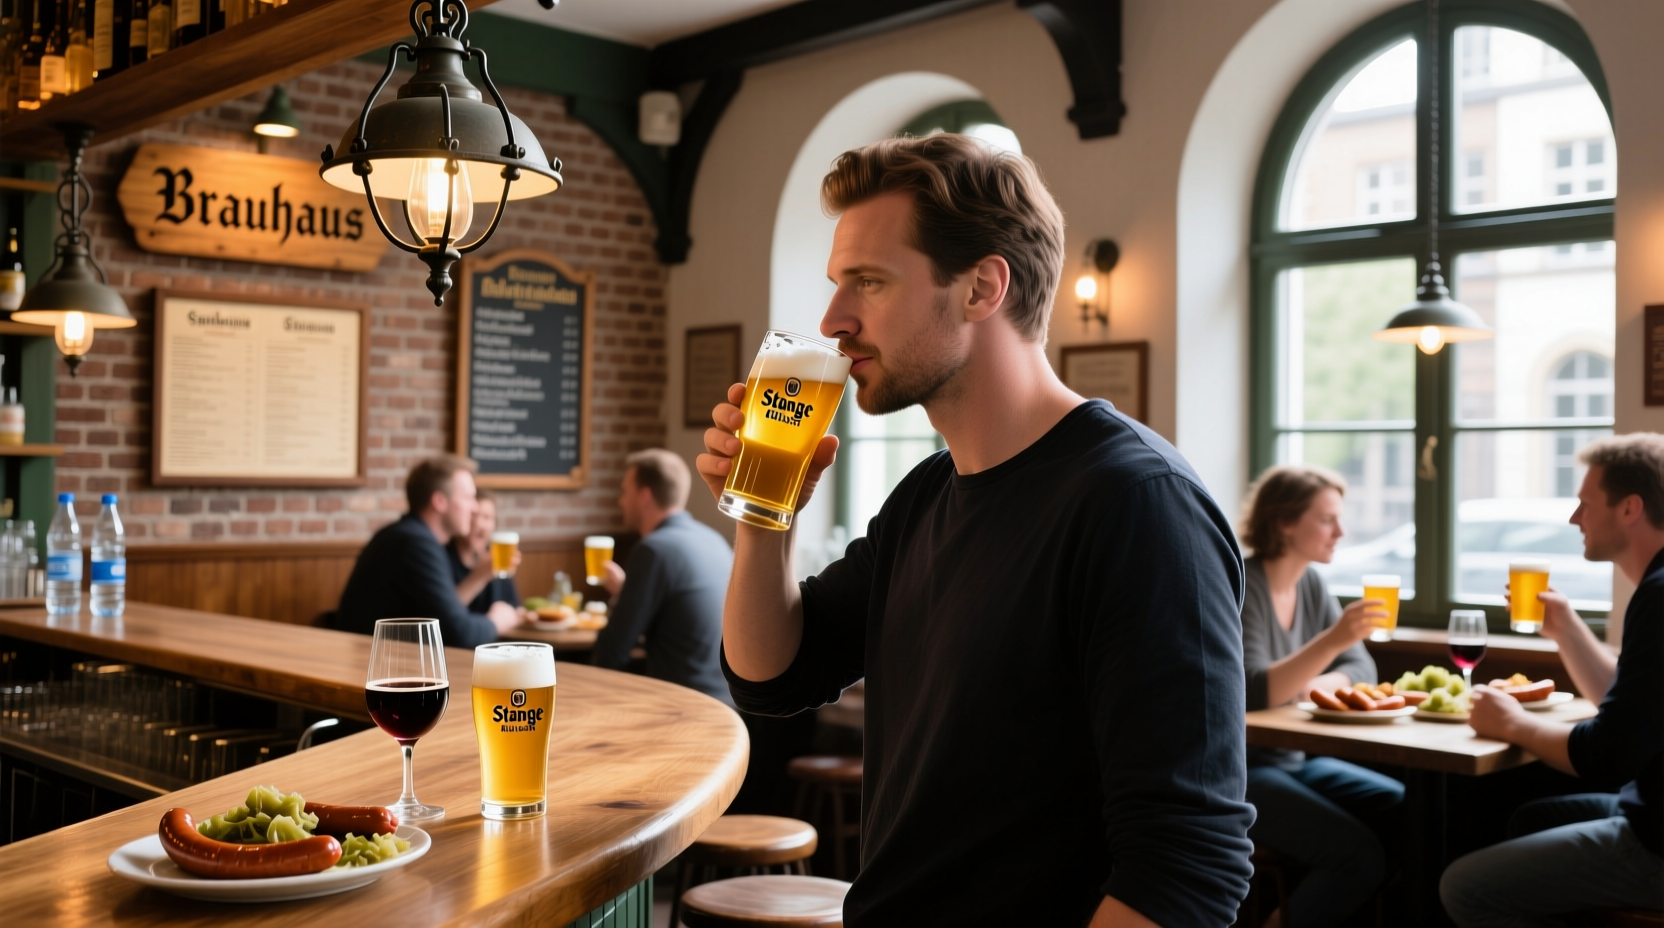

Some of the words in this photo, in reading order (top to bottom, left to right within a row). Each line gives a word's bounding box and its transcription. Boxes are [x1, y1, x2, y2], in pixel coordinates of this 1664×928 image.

[153, 166, 364, 247] Brauhaus
[761, 388, 814, 419] Stange
[492, 705, 544, 726] Stange
